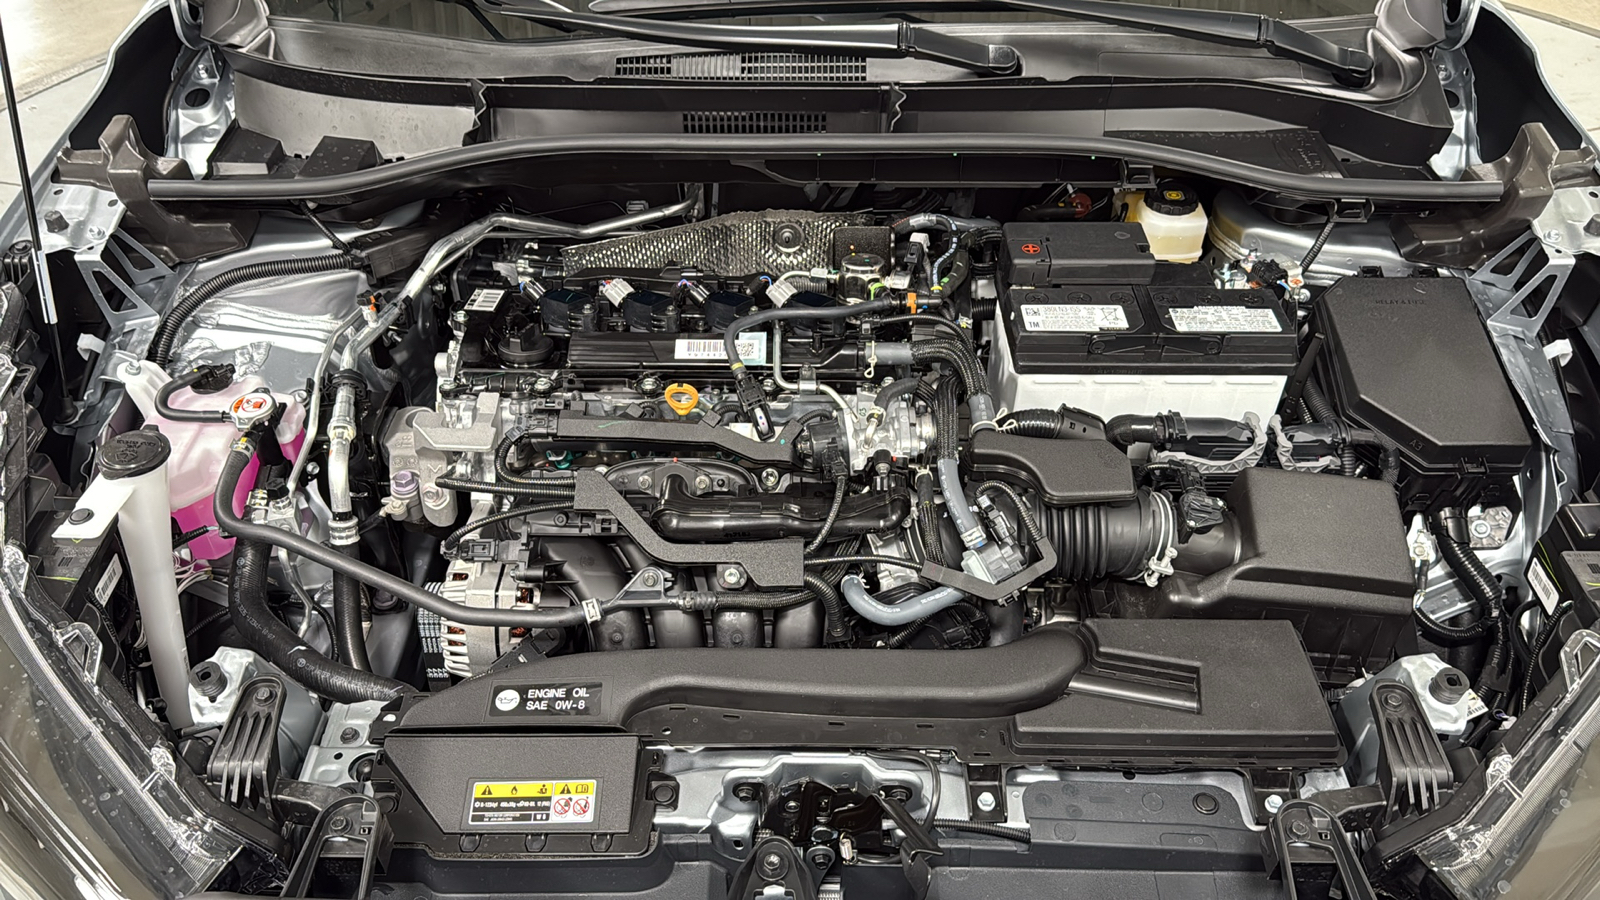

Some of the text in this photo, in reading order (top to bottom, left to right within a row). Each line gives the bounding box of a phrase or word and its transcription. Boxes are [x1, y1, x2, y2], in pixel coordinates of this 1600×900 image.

[1028, 321, 1040, 329] TM
[528, 687, 589, 698] ENGINE OIL
[526, 700, 586, 710] SAE 0W-8
